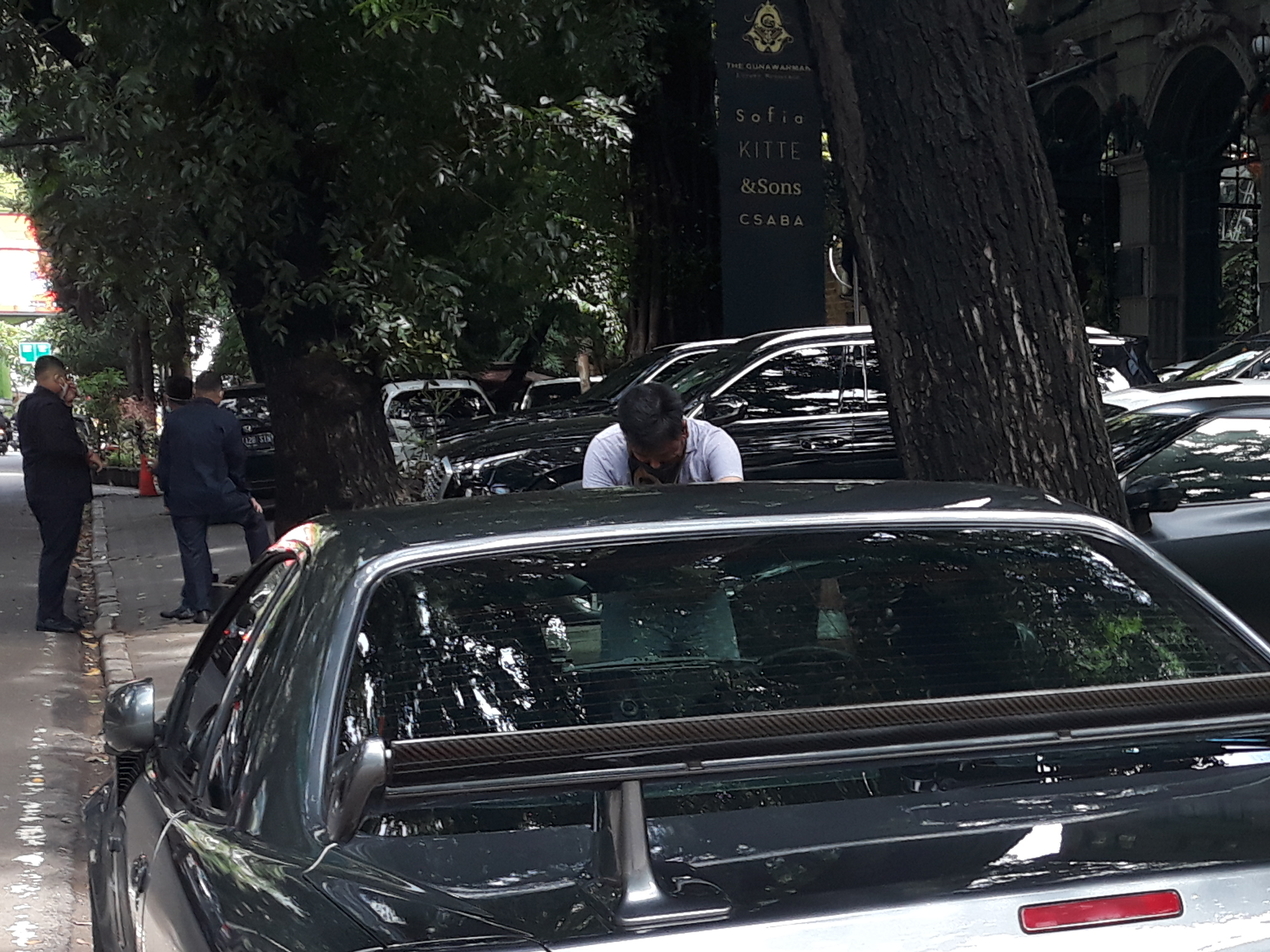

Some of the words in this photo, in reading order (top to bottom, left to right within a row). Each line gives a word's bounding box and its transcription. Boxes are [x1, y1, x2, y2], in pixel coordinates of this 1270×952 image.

[736, 106, 804, 125] Sofia
[739, 140, 801, 161] KITTE
[740, 178, 802, 196] &Sons
[739, 213, 804, 227] CSABA
